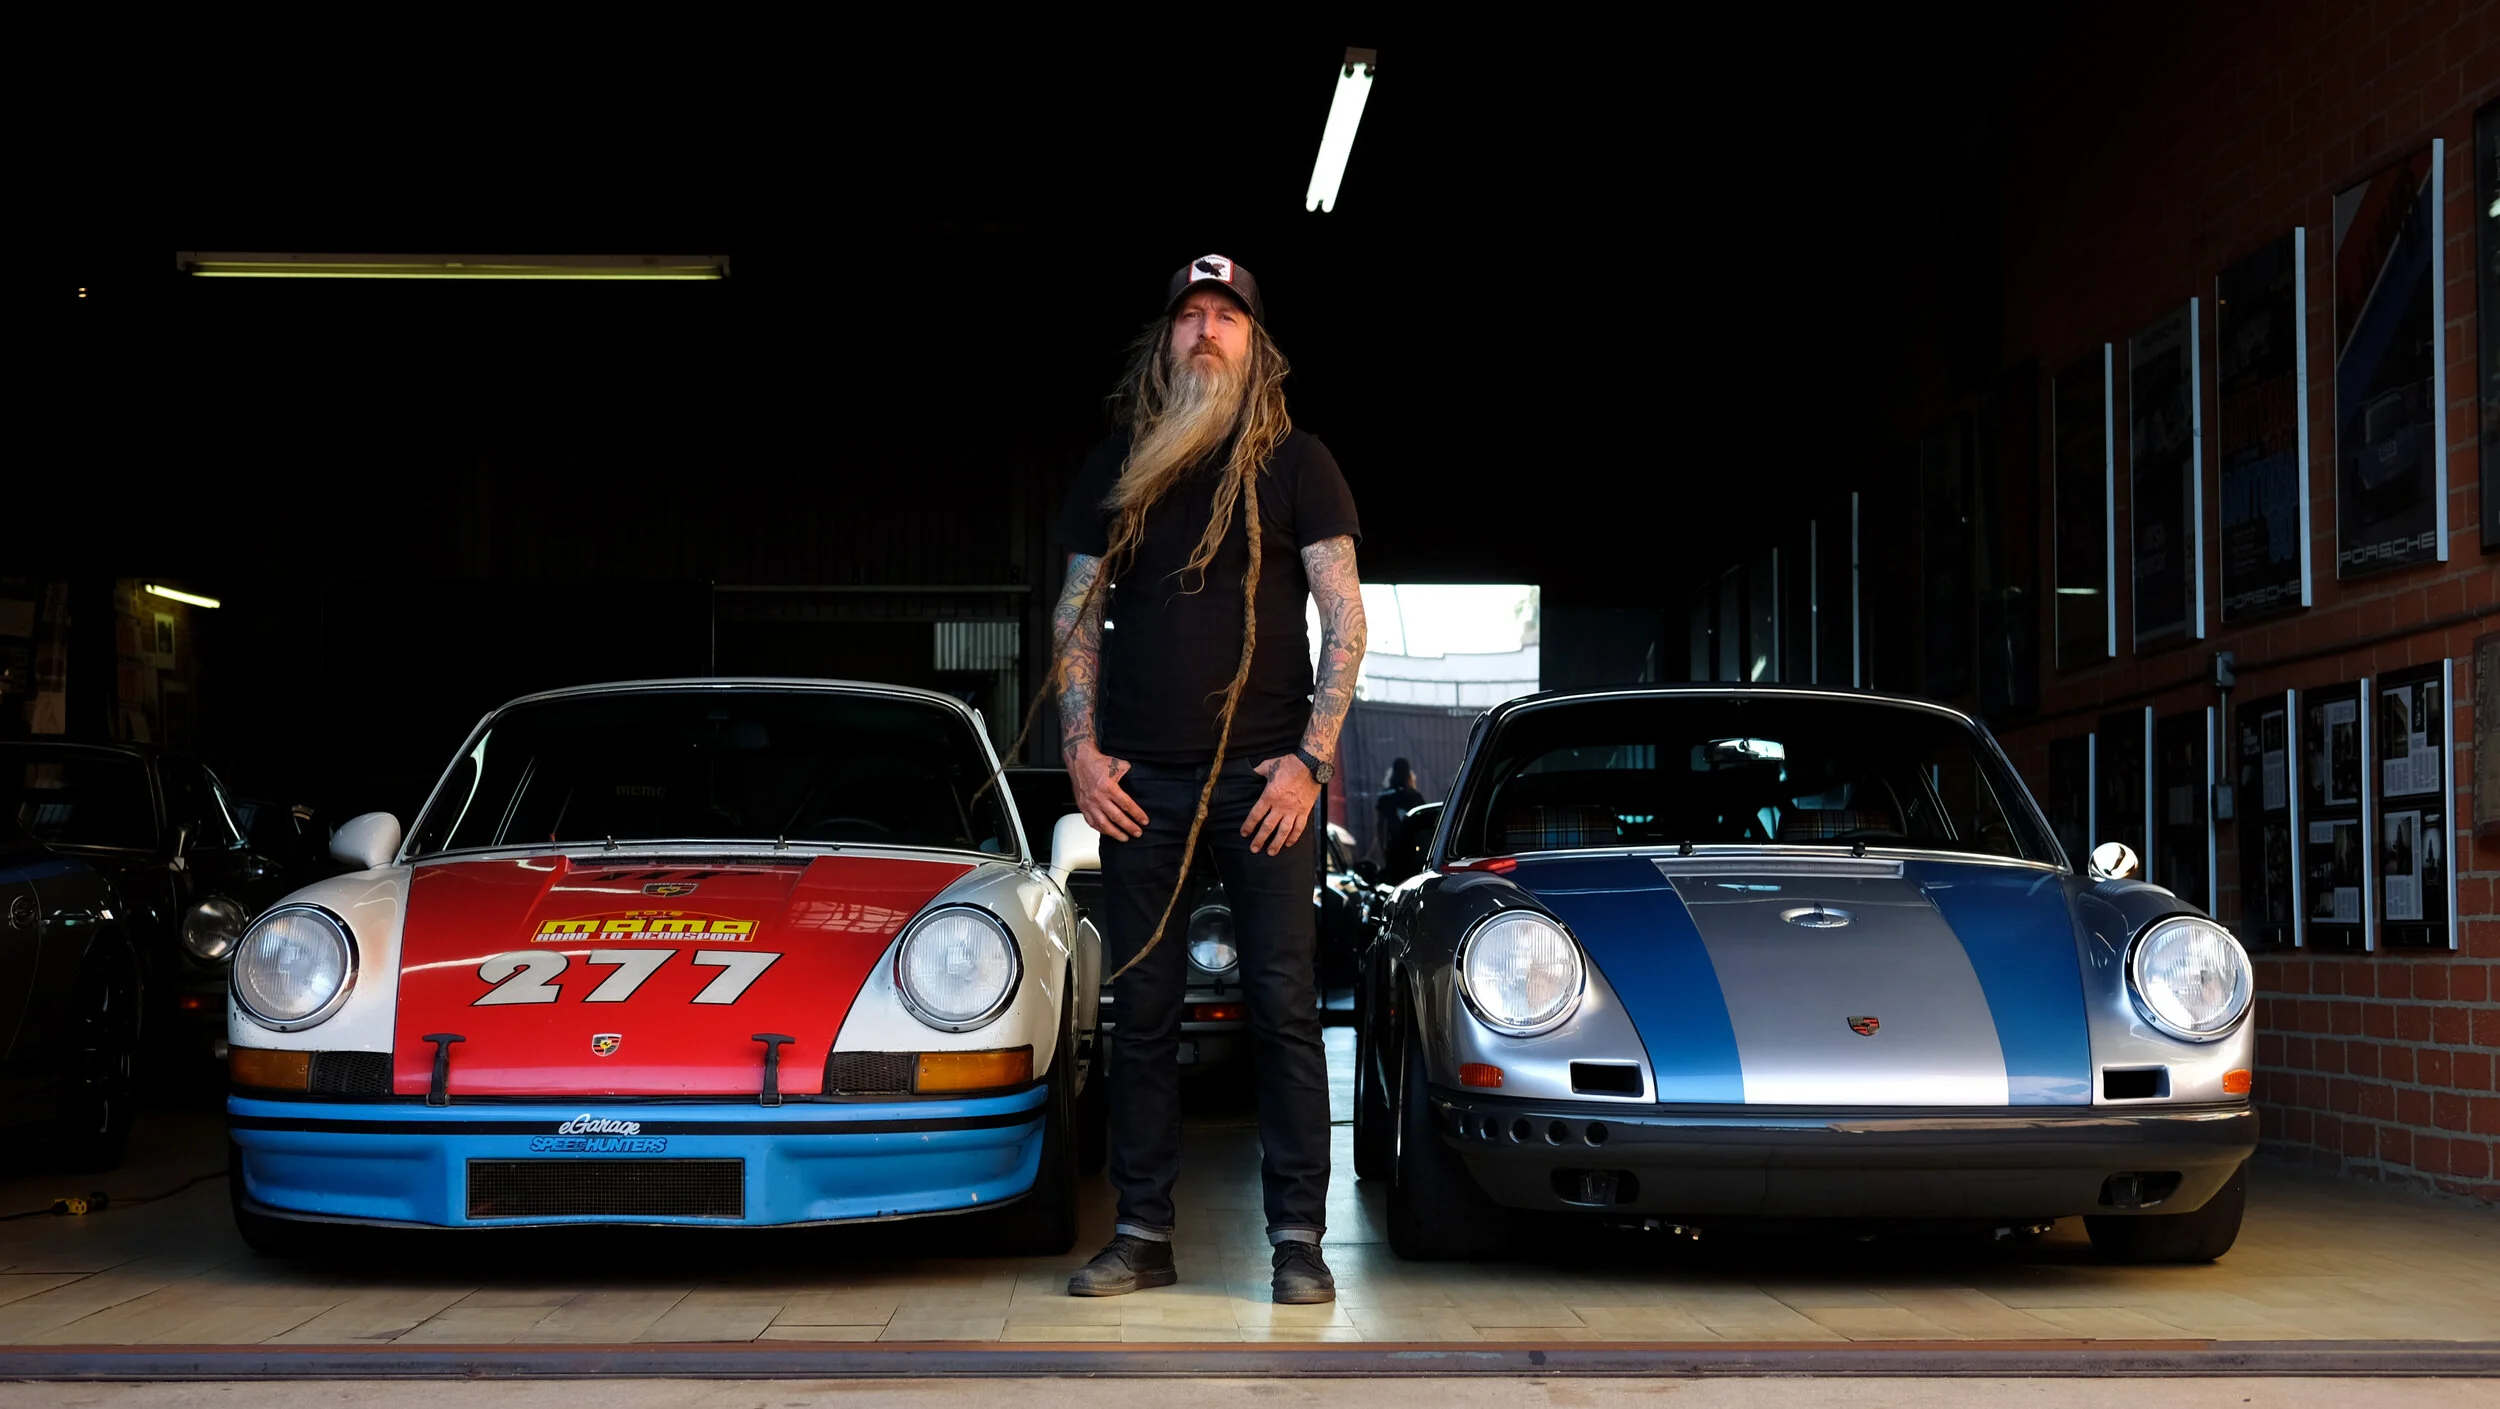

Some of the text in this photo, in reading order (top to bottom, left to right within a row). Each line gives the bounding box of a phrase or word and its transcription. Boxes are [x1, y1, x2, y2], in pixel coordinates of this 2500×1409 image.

[2340, 530, 2435, 568] PORSCHE
[2223, 578, 2300, 610] PORSCHE
[535, 932, 589, 941] ROAD
[600, 932, 624, 940] TO
[469, 948, 784, 1006] 277
[558, 1113, 640, 1136] eGarage
[530, 1136, 667, 1153] SPEEDHUNTERS
